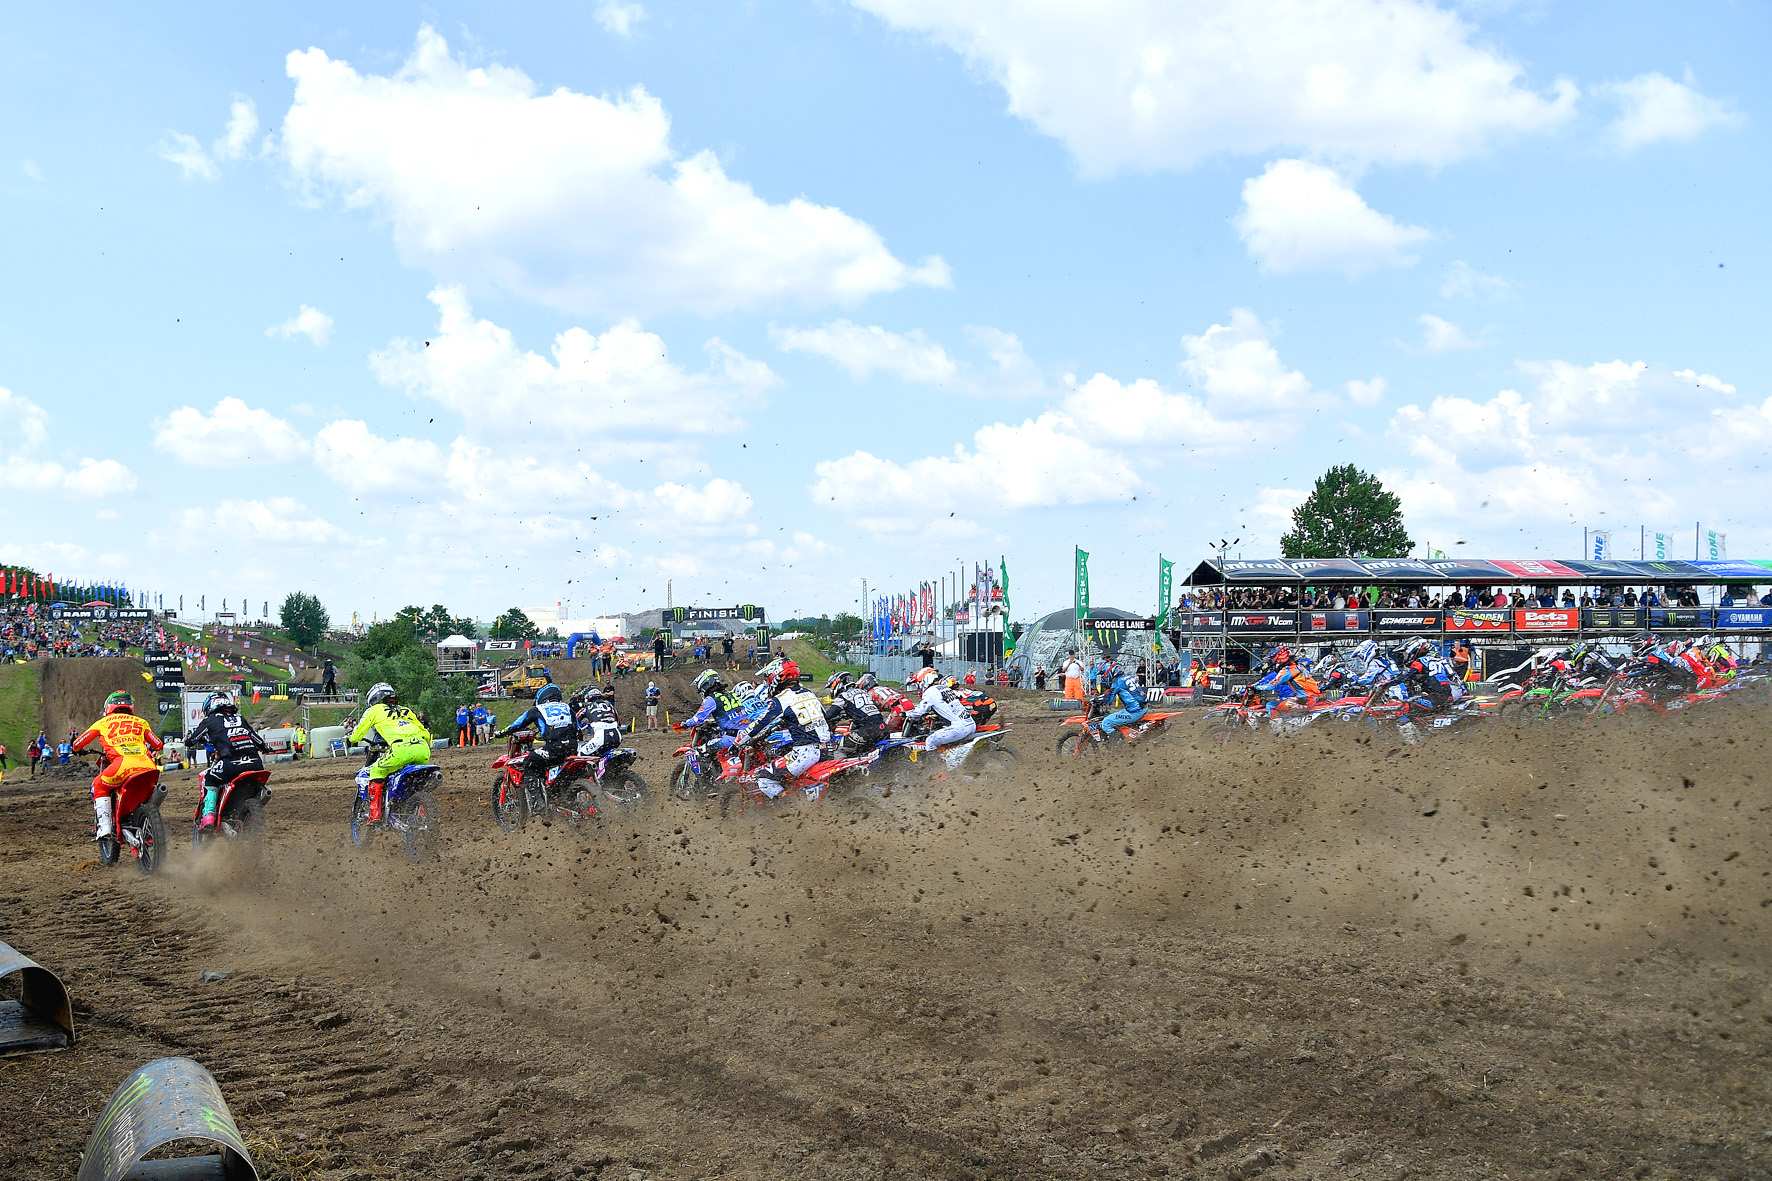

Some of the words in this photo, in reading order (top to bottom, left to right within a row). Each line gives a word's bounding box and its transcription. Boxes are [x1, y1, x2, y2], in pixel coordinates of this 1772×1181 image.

[689, 609, 739, 619] FINISH
[1525, 612, 1568, 620] Beta
[1737, 613, 1763, 622] YAMAHA
[1094, 620, 1125, 629] GOGGLE
[1126, 620, 1146, 629] LANE
[1380, 617, 1424, 625] SCHMICKER
[107, 720, 143, 740] 255
